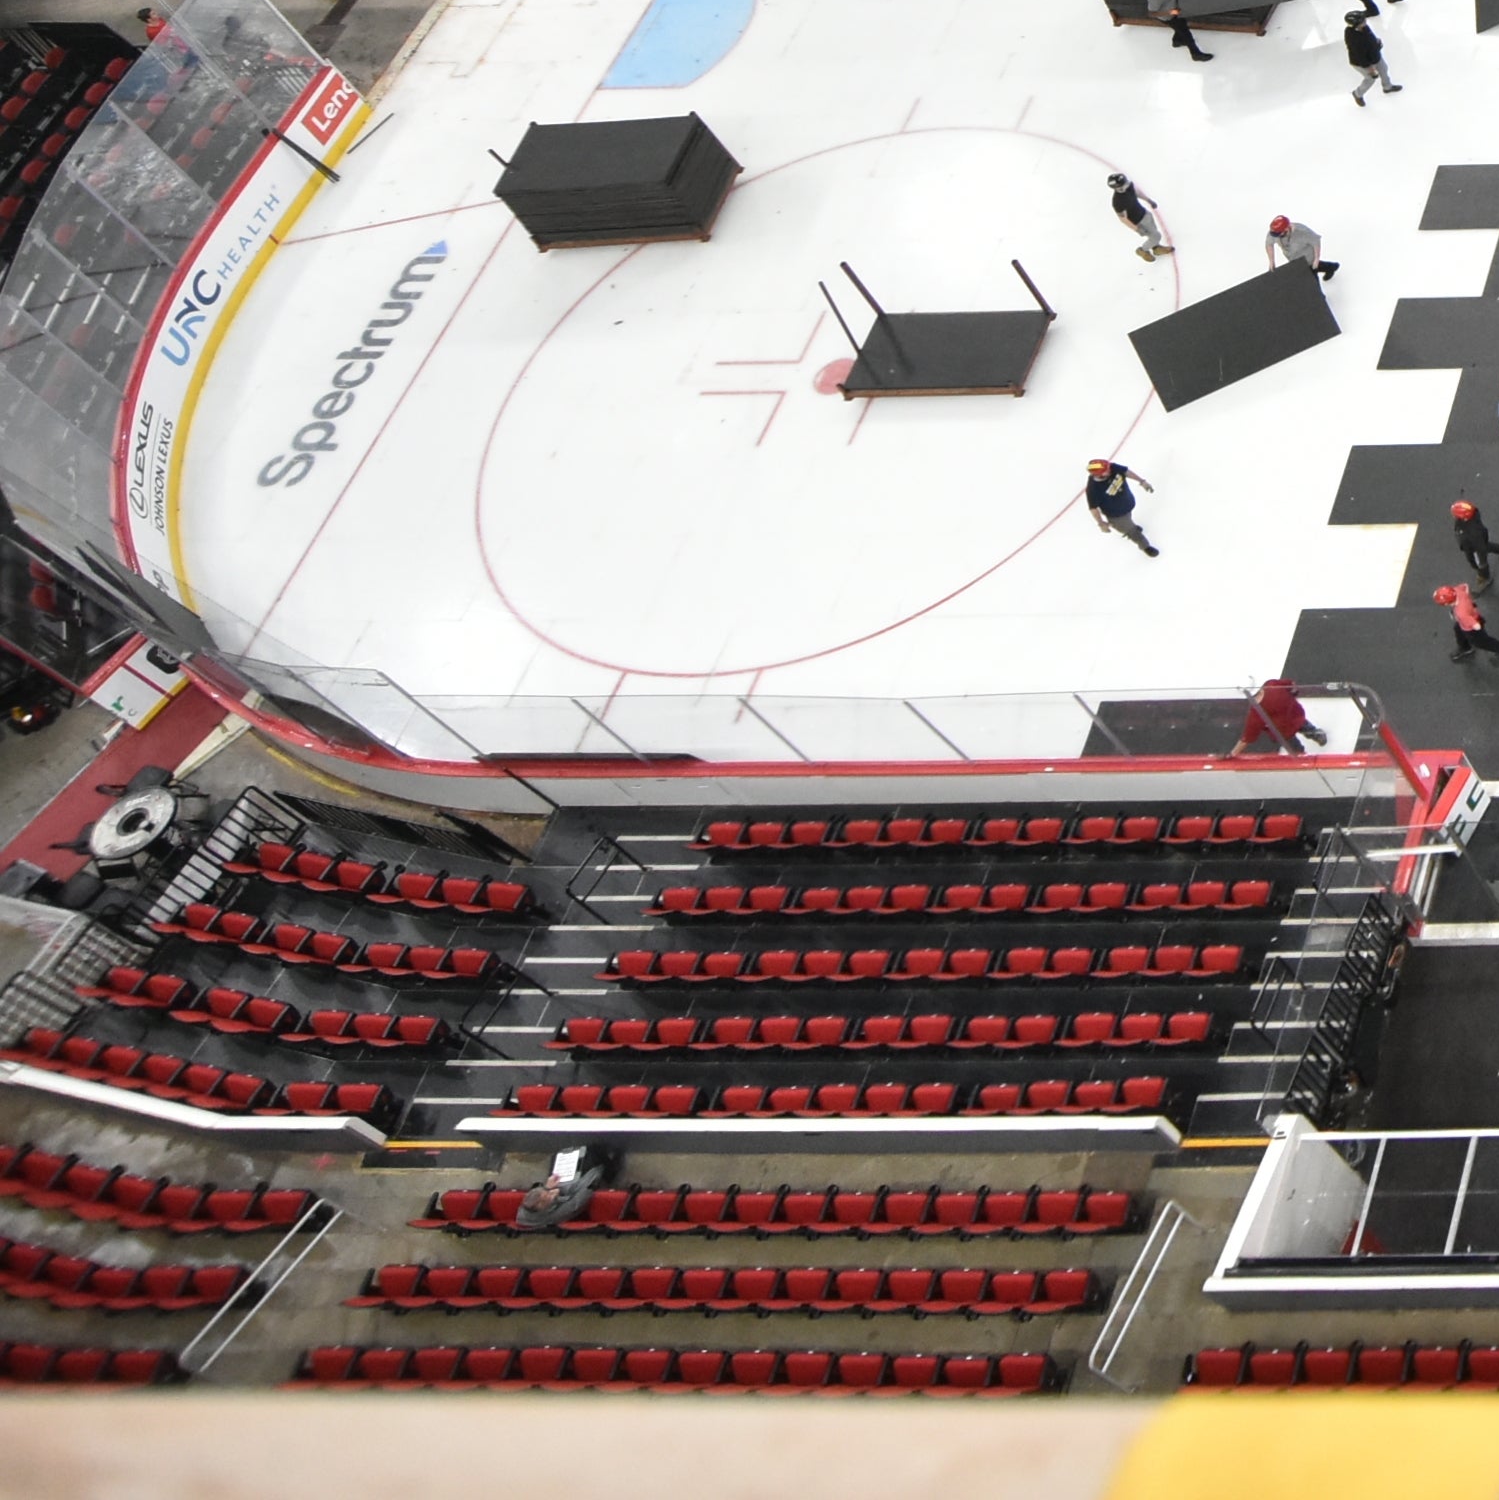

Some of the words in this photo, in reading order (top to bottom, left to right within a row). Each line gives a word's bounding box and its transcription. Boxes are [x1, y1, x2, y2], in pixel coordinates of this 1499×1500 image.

[161, 269, 221, 366] UNC
[217, 193, 280, 280] HEALTH
[257, 256, 447, 488] Spectrum
[133, 401, 154, 487] LEXUS
[157, 418, 173, 465] LEXUS
[154, 466, 165, 536] JOHNSON
